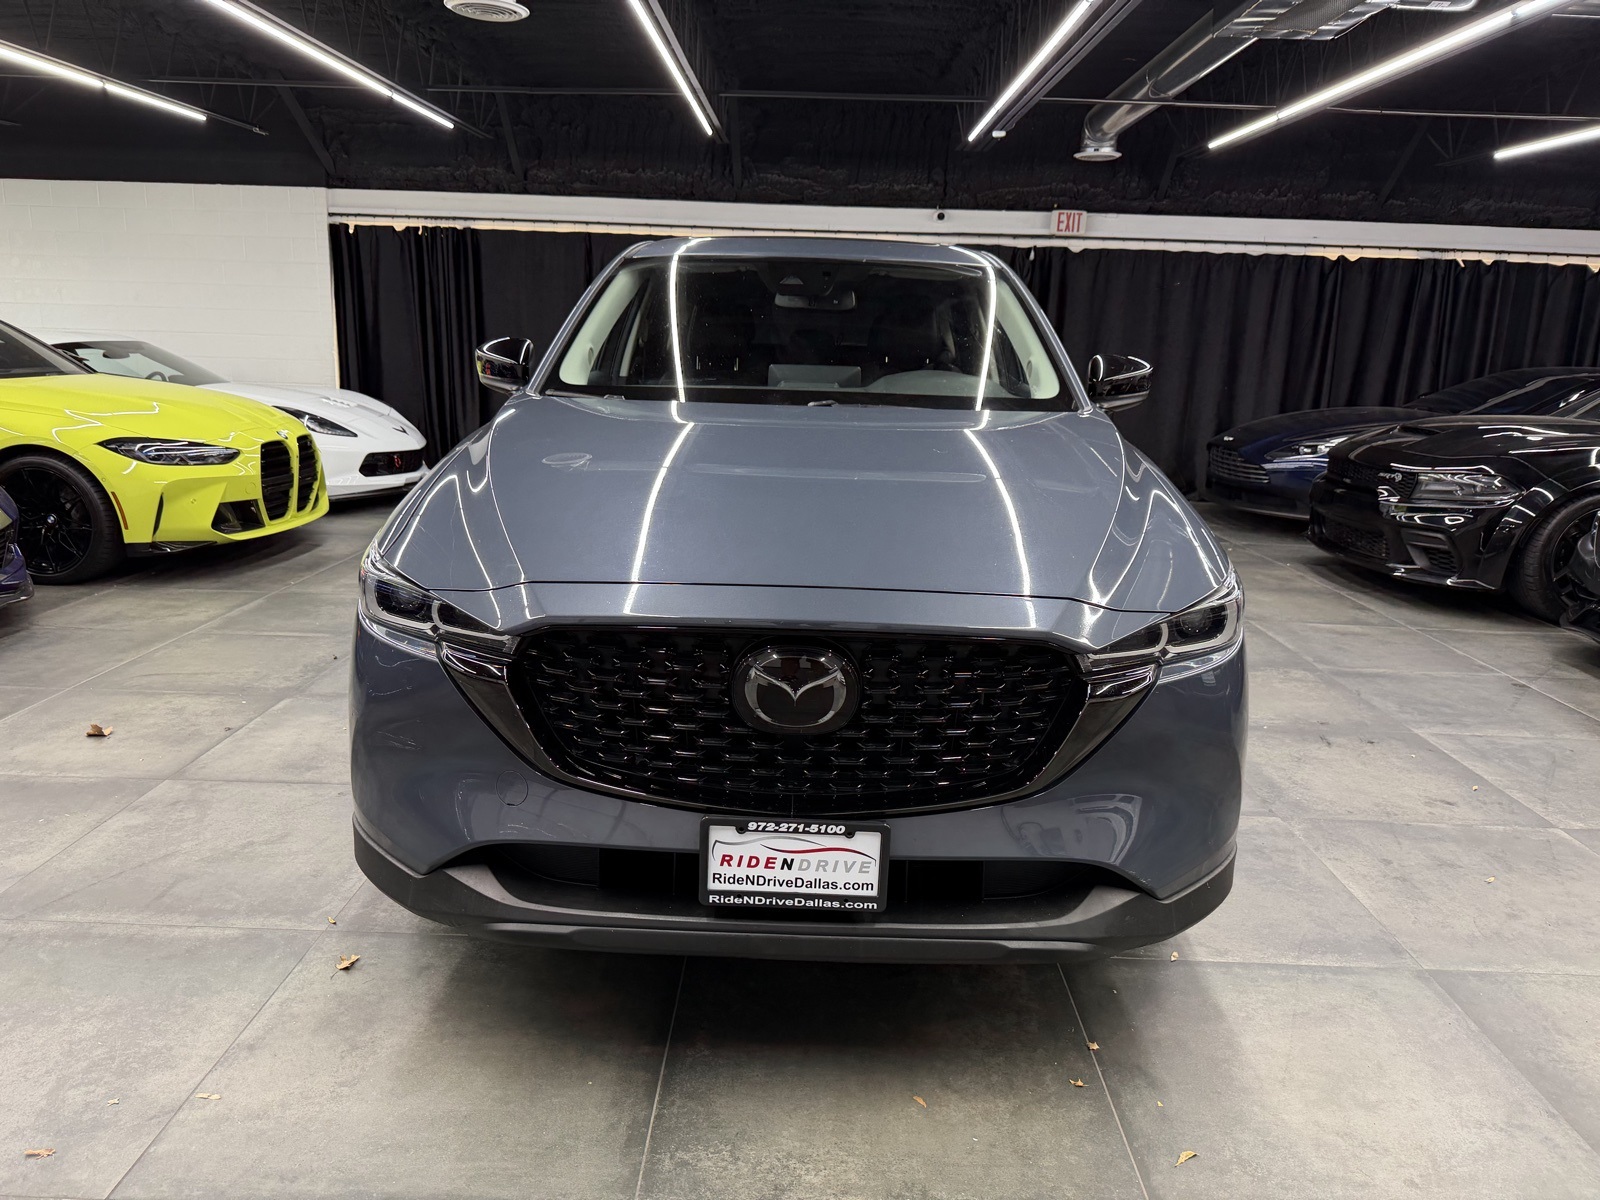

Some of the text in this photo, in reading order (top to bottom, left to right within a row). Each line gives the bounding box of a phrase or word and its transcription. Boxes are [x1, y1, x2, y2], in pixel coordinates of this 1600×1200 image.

[1056, 211, 1083, 232] EXIT
[747, 821, 846, 834] 972-271-5100
[712, 872, 874, 891] RideNDriveDallas.com
[709, 894, 878, 910] RideNDriveDallas.com
